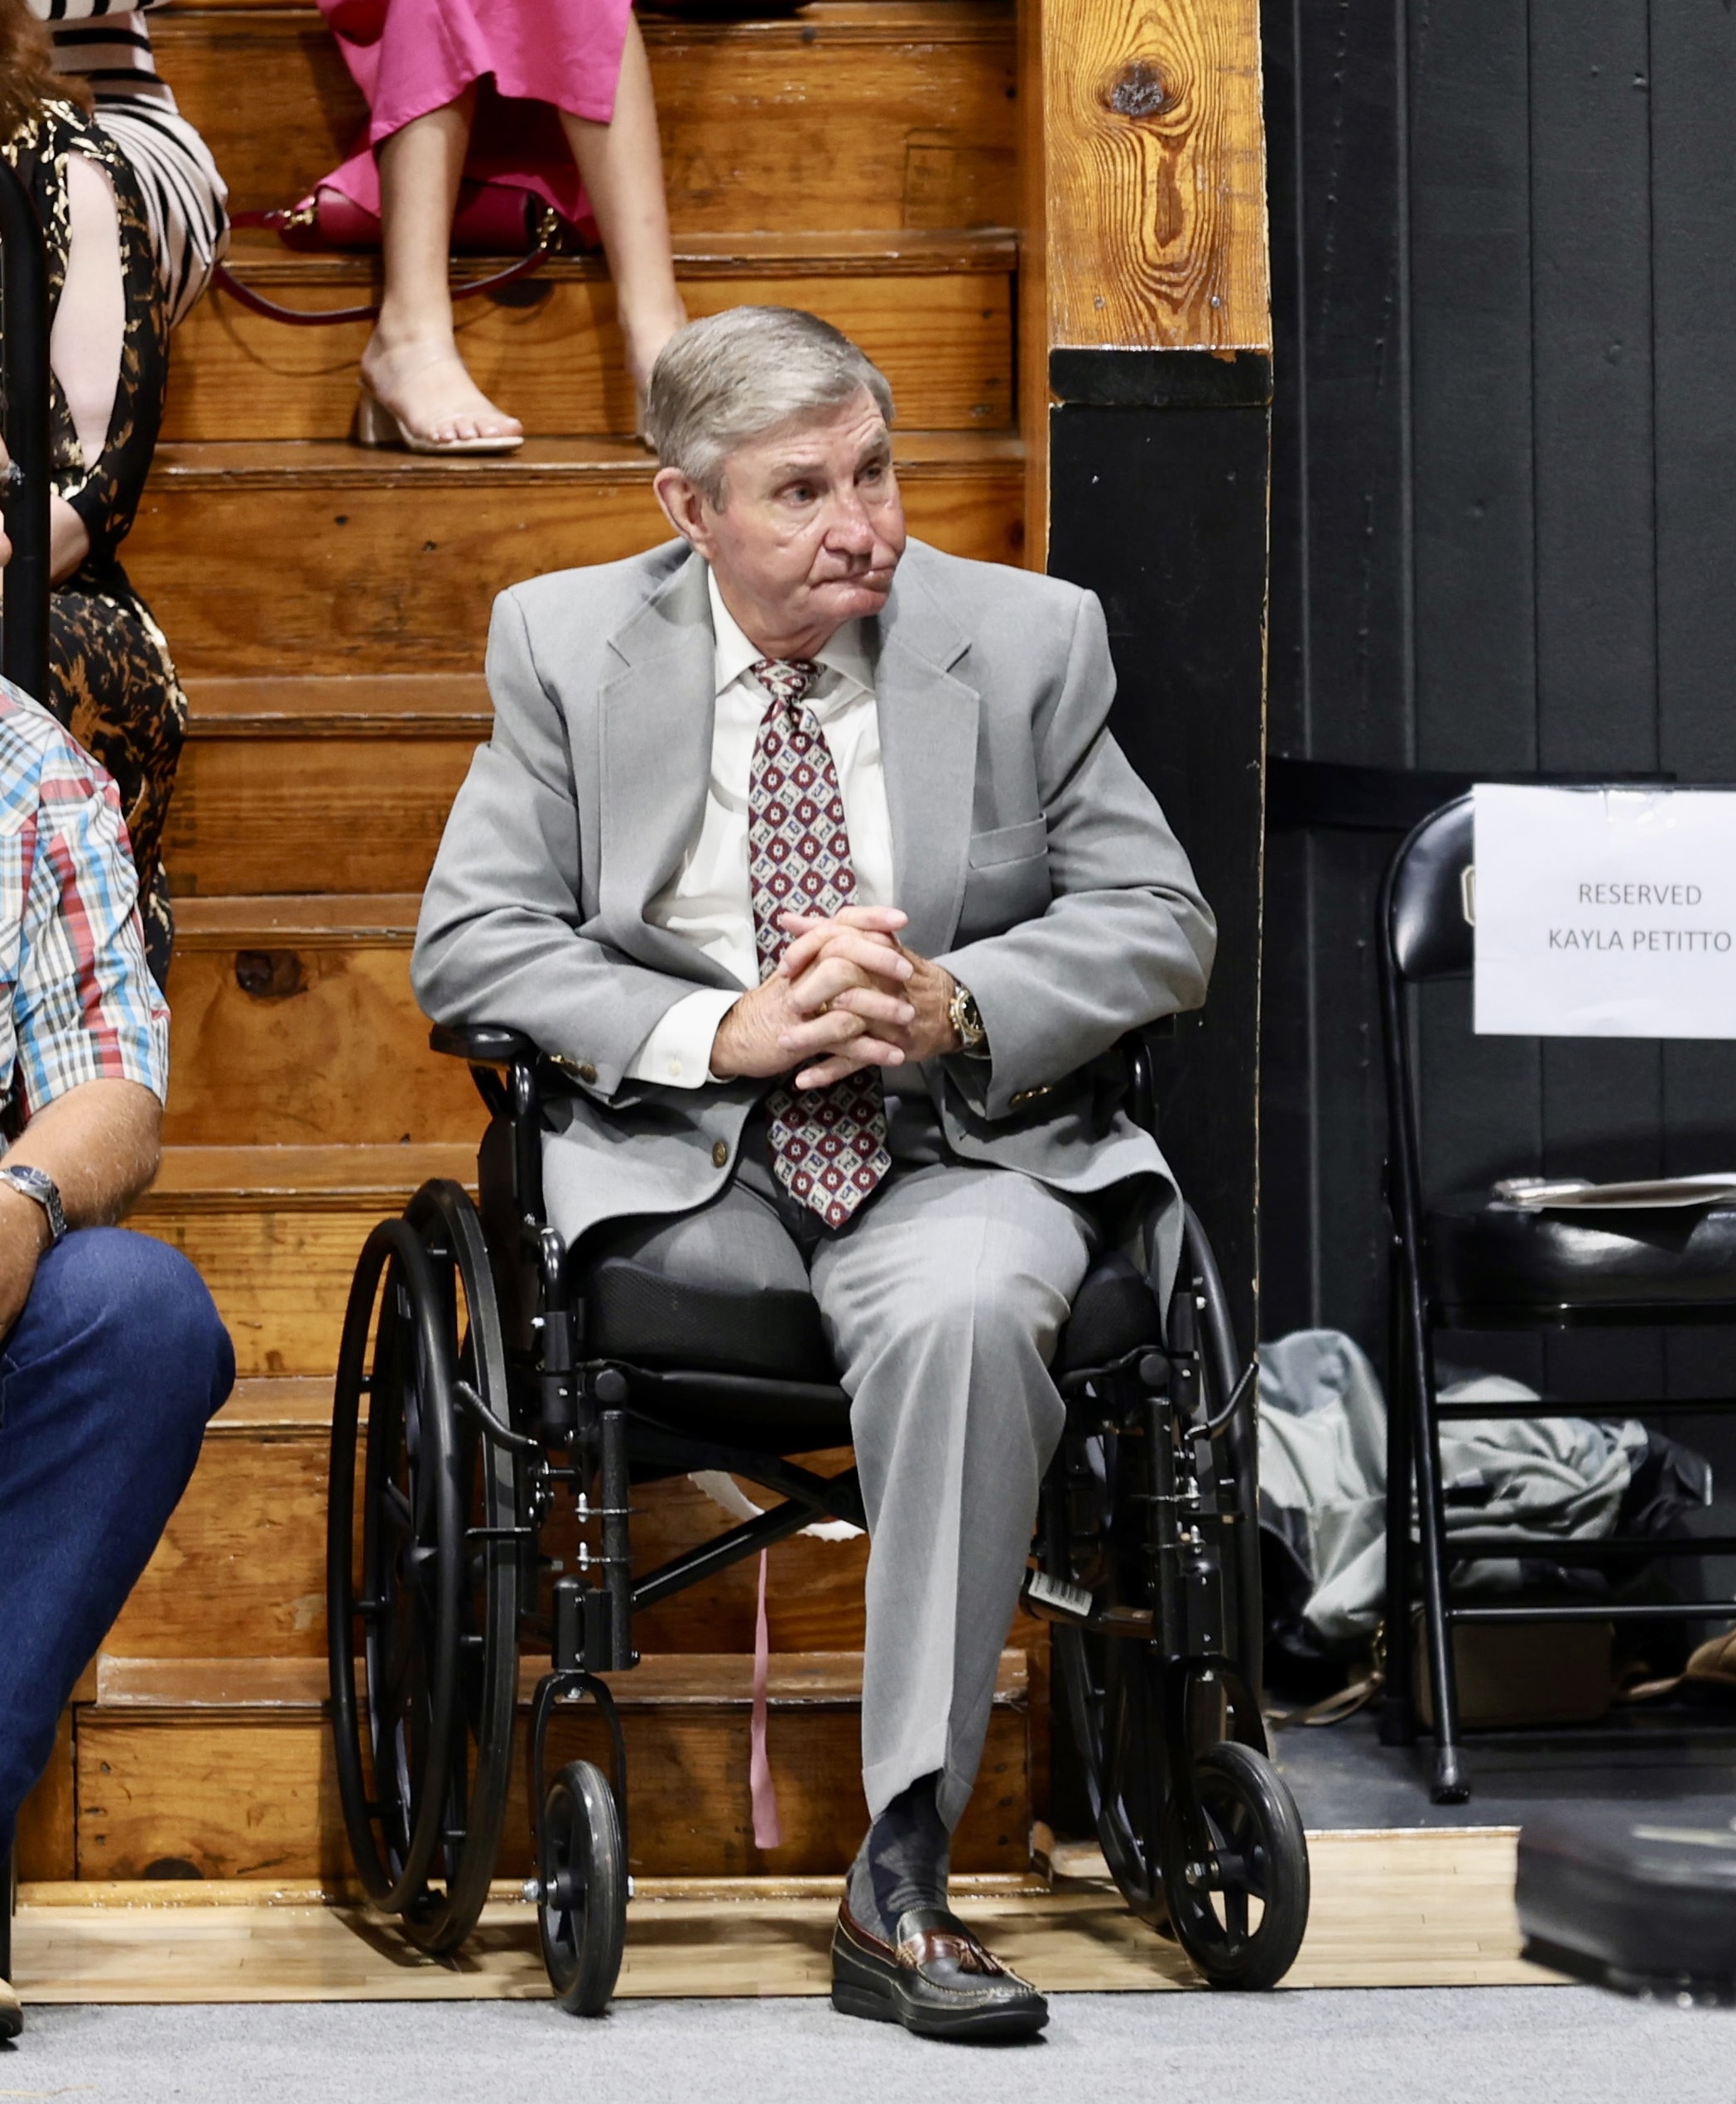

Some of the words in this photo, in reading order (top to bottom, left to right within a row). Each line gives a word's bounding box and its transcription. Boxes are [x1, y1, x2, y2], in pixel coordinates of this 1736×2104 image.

[1579, 883, 1702, 905] RESERVED
[1549, 928, 1624, 951] KAYLA
[1633, 930, 1732, 952] PETITTO
